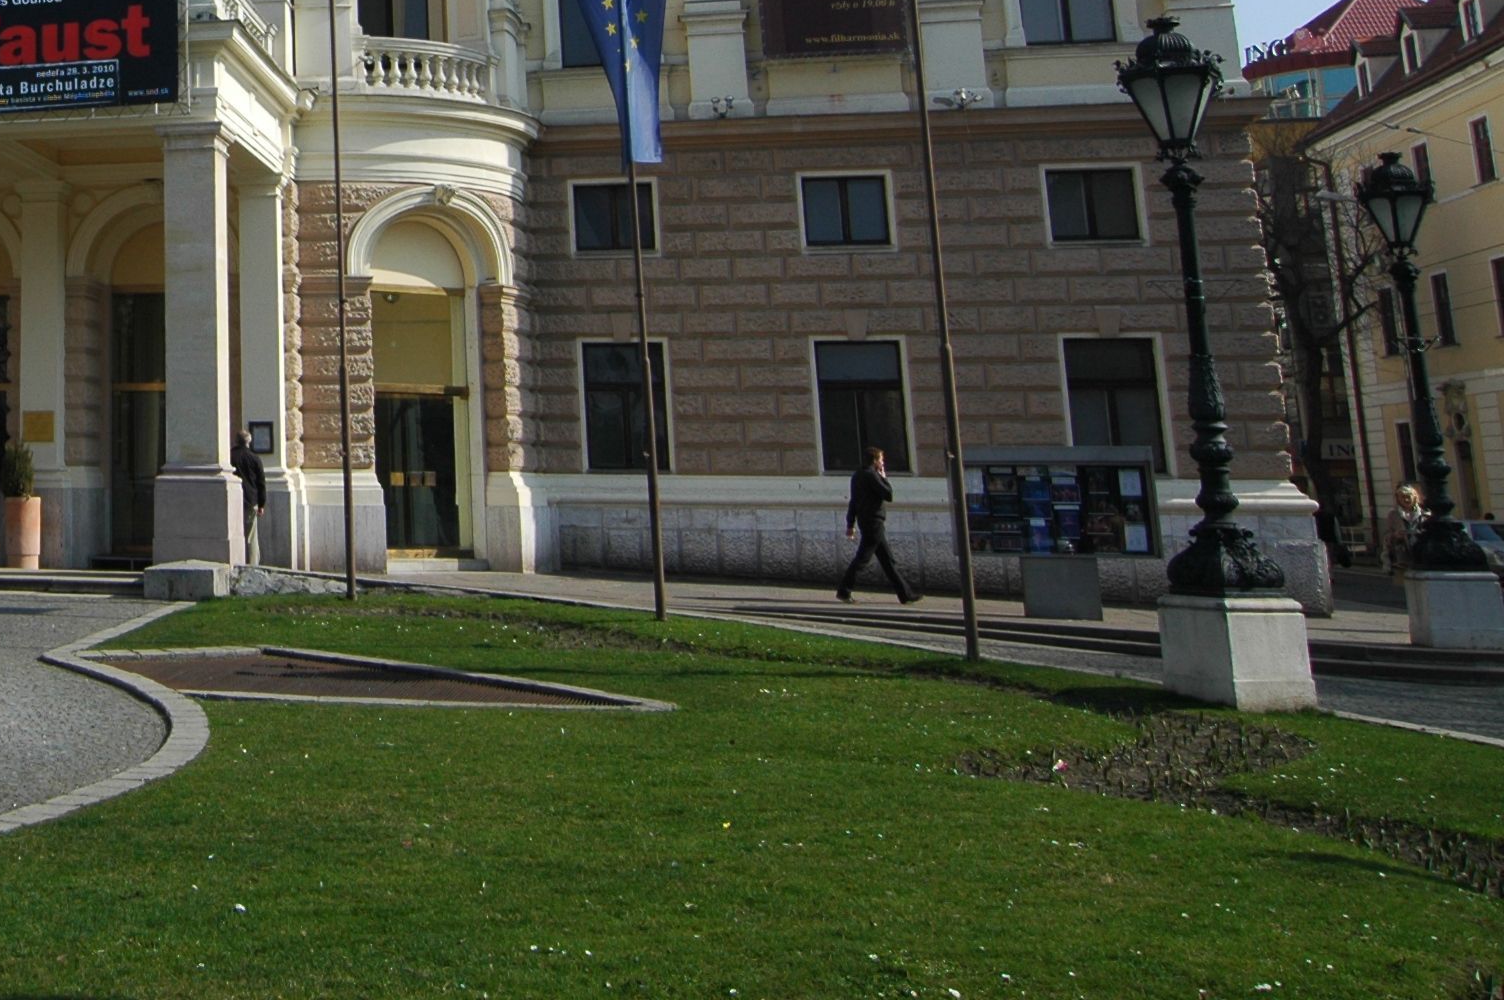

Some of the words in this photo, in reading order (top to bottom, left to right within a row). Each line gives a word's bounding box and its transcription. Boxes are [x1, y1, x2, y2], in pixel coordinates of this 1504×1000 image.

[1245, 39, 1287, 64] ING
[67, 67, 81, 76] 28.
[82, 66, 90, 74] 3.
[92, 64, 115, 74] 2010
[20, 76, 115, 95] Burchuladze
[127, 87, 169, 97] www.snd.sk
[1329, 443, 1355, 457] IN
